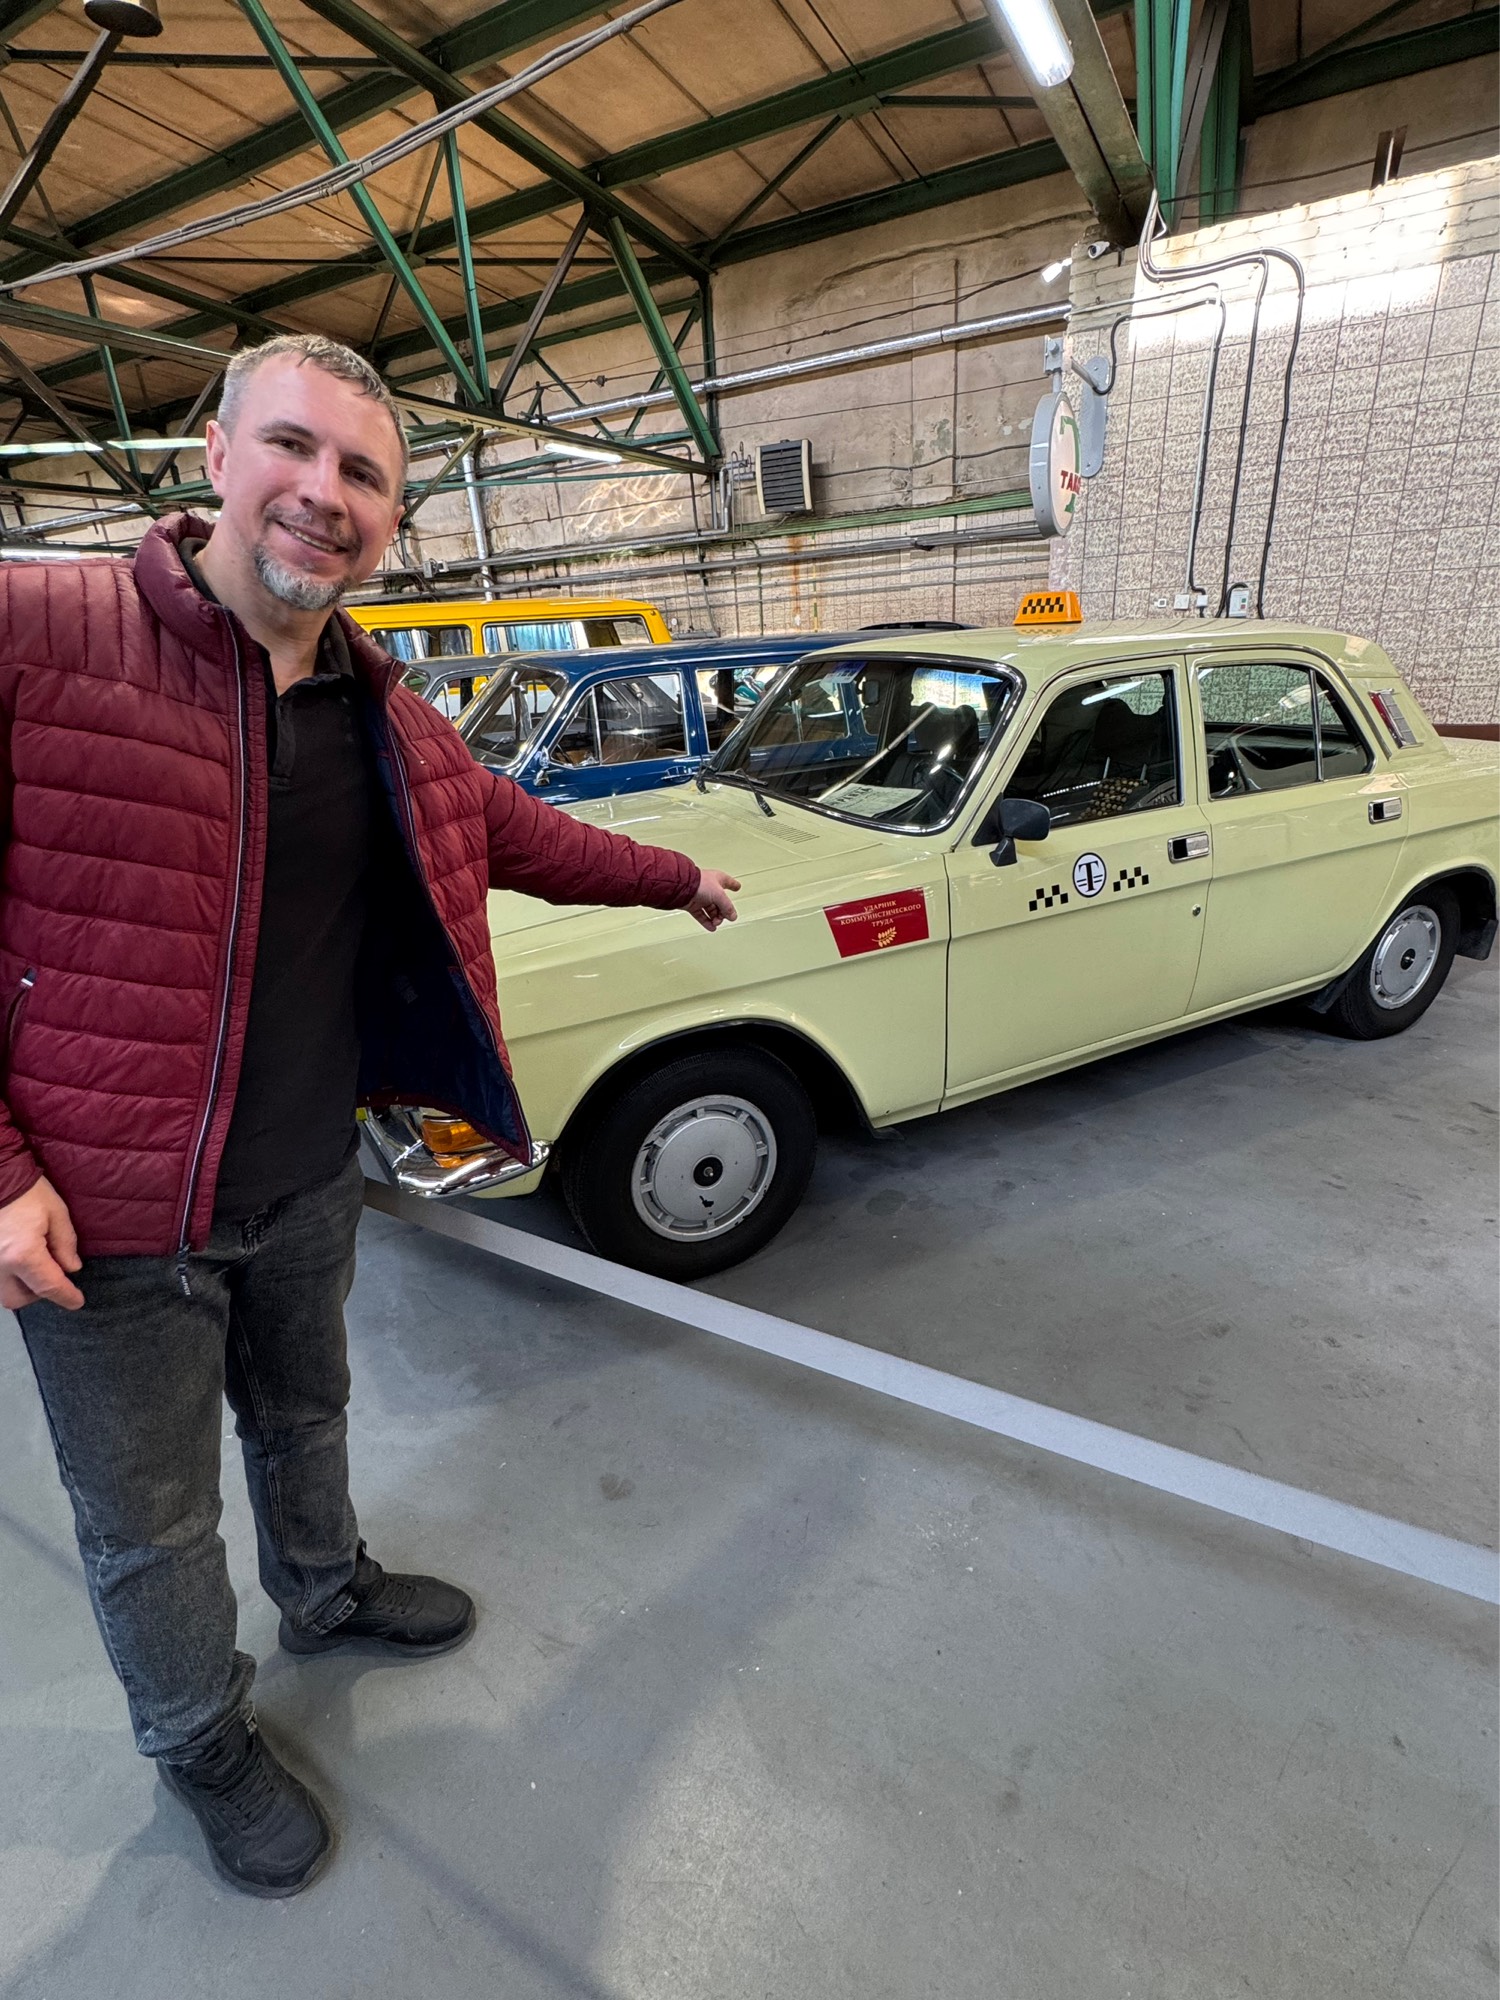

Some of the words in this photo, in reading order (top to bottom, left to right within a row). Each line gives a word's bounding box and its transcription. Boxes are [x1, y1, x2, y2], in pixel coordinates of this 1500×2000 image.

[864, 900, 897, 913] УДАРНИК
[840, 903, 922, 926] КОММУНИСТИЧЕСКОГО
[871, 918, 894, 927] ТРУДА
